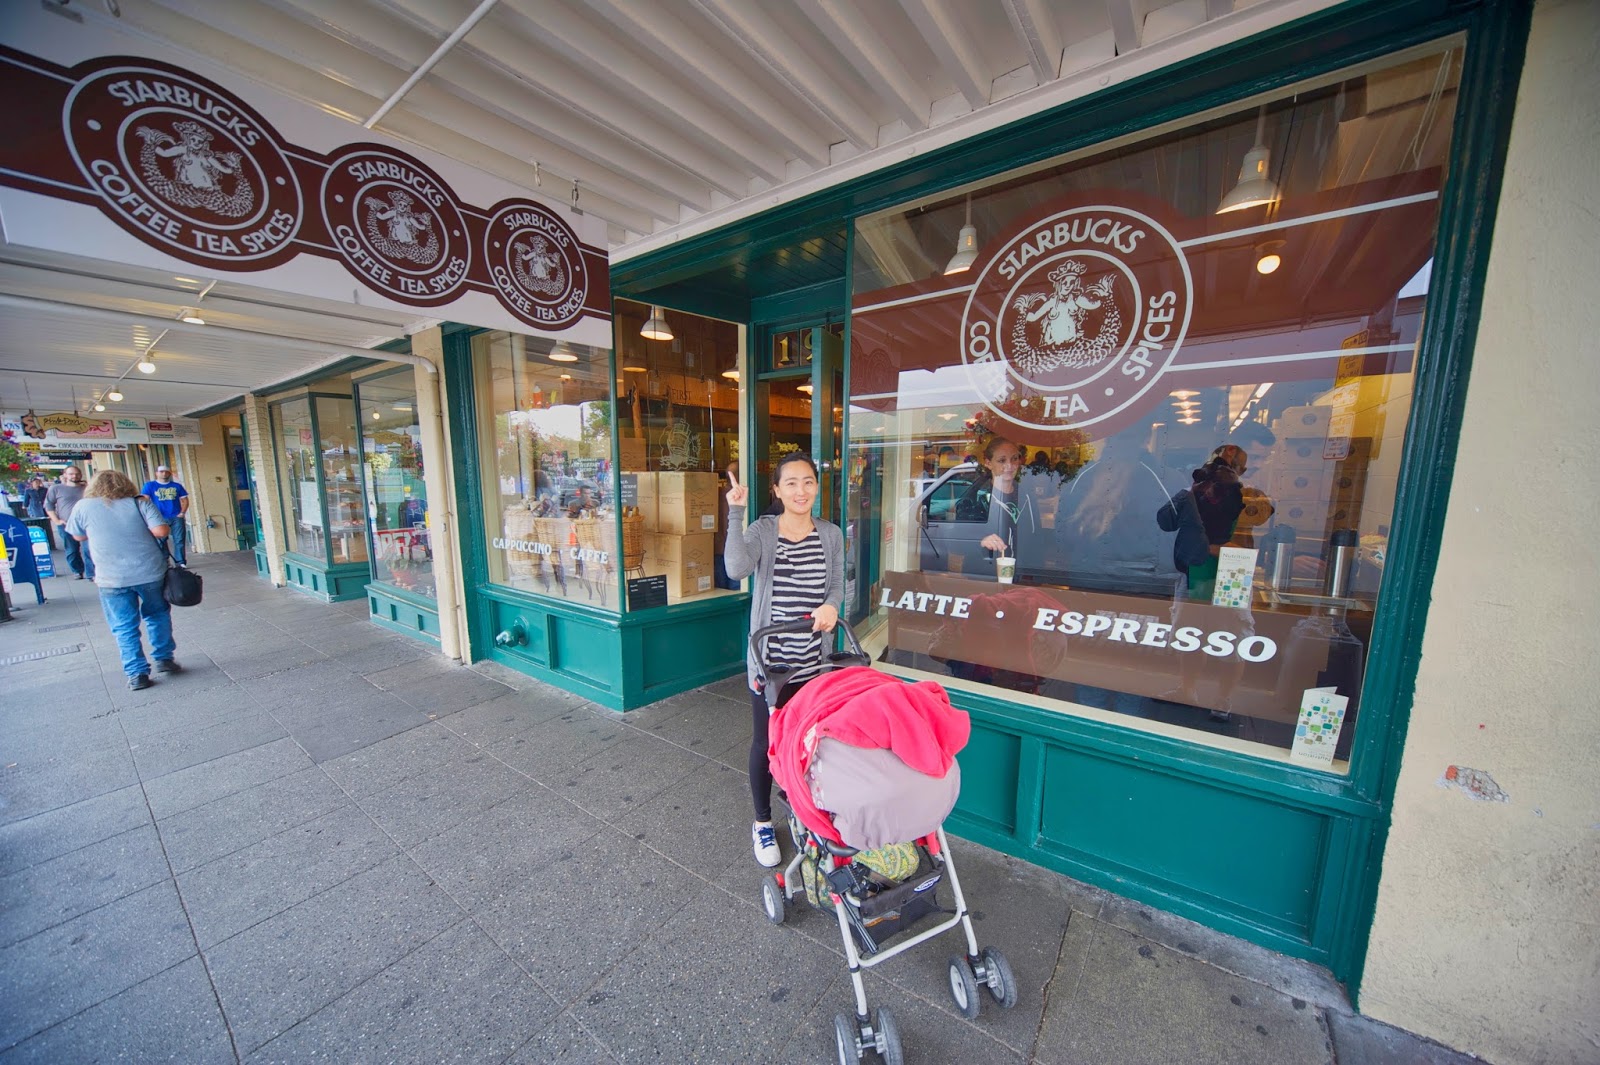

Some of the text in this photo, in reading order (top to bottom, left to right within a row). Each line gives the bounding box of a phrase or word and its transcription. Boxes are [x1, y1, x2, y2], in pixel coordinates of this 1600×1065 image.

[107, 80, 261, 147] STARBUCKS
[90, 159, 295, 254] COFFEE TEA SPICES
[348, 161, 445, 207] STARBUCKS
[336, 224, 466, 294] COFFEE TEA SPICES
[503, 212, 570, 248] STARBUCKS
[998, 218, 1146, 280] STARBUCKS
[493, 265, 584, 320] COFFEE TEA SPICES
[1042, 393, 1090, 418] TEA
[1121, 290, 1177, 382] SPICES
[492, 537, 609, 564] CAPPUCCINO CAFFE
[879, 587, 1278, 663] LATTE ESPRESSO
[1298, 752, 1332, 762] Nutrition
